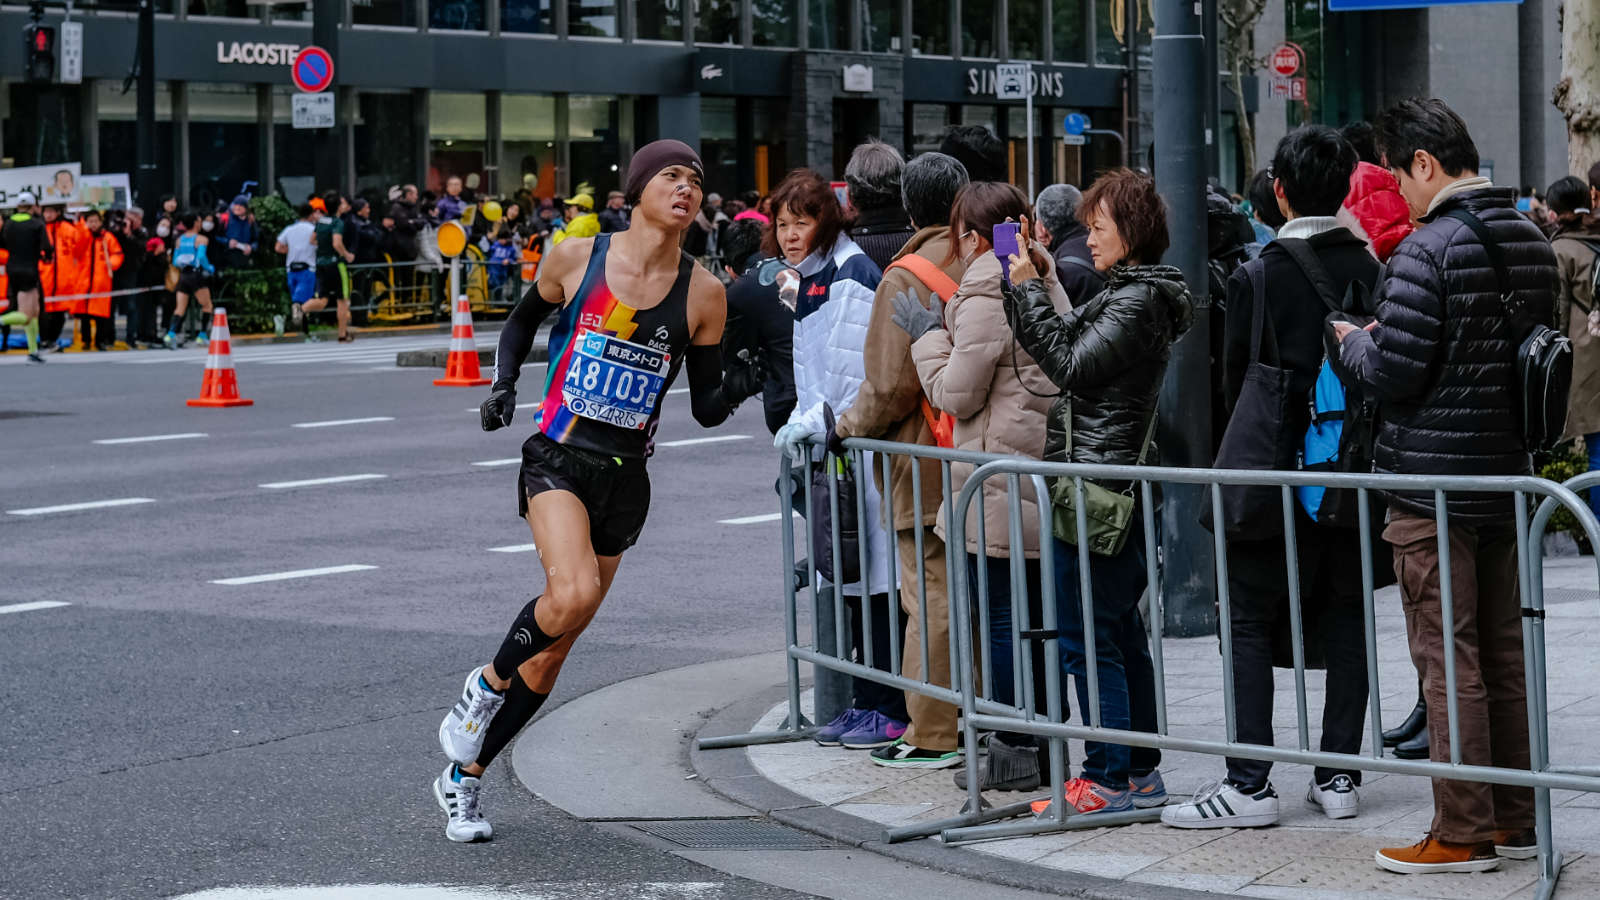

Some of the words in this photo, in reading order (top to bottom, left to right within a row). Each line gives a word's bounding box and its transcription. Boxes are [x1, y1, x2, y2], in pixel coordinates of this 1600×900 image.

[217, 41, 300, 65] LACOSTE
[968, 68, 1064, 98] SIMONS
[1000, 68, 1024, 77] TAXI
[607, 345, 660, 368] 東京メトロ
[648, 339, 671, 352] PACE
[565, 356, 649, 404] A8103
